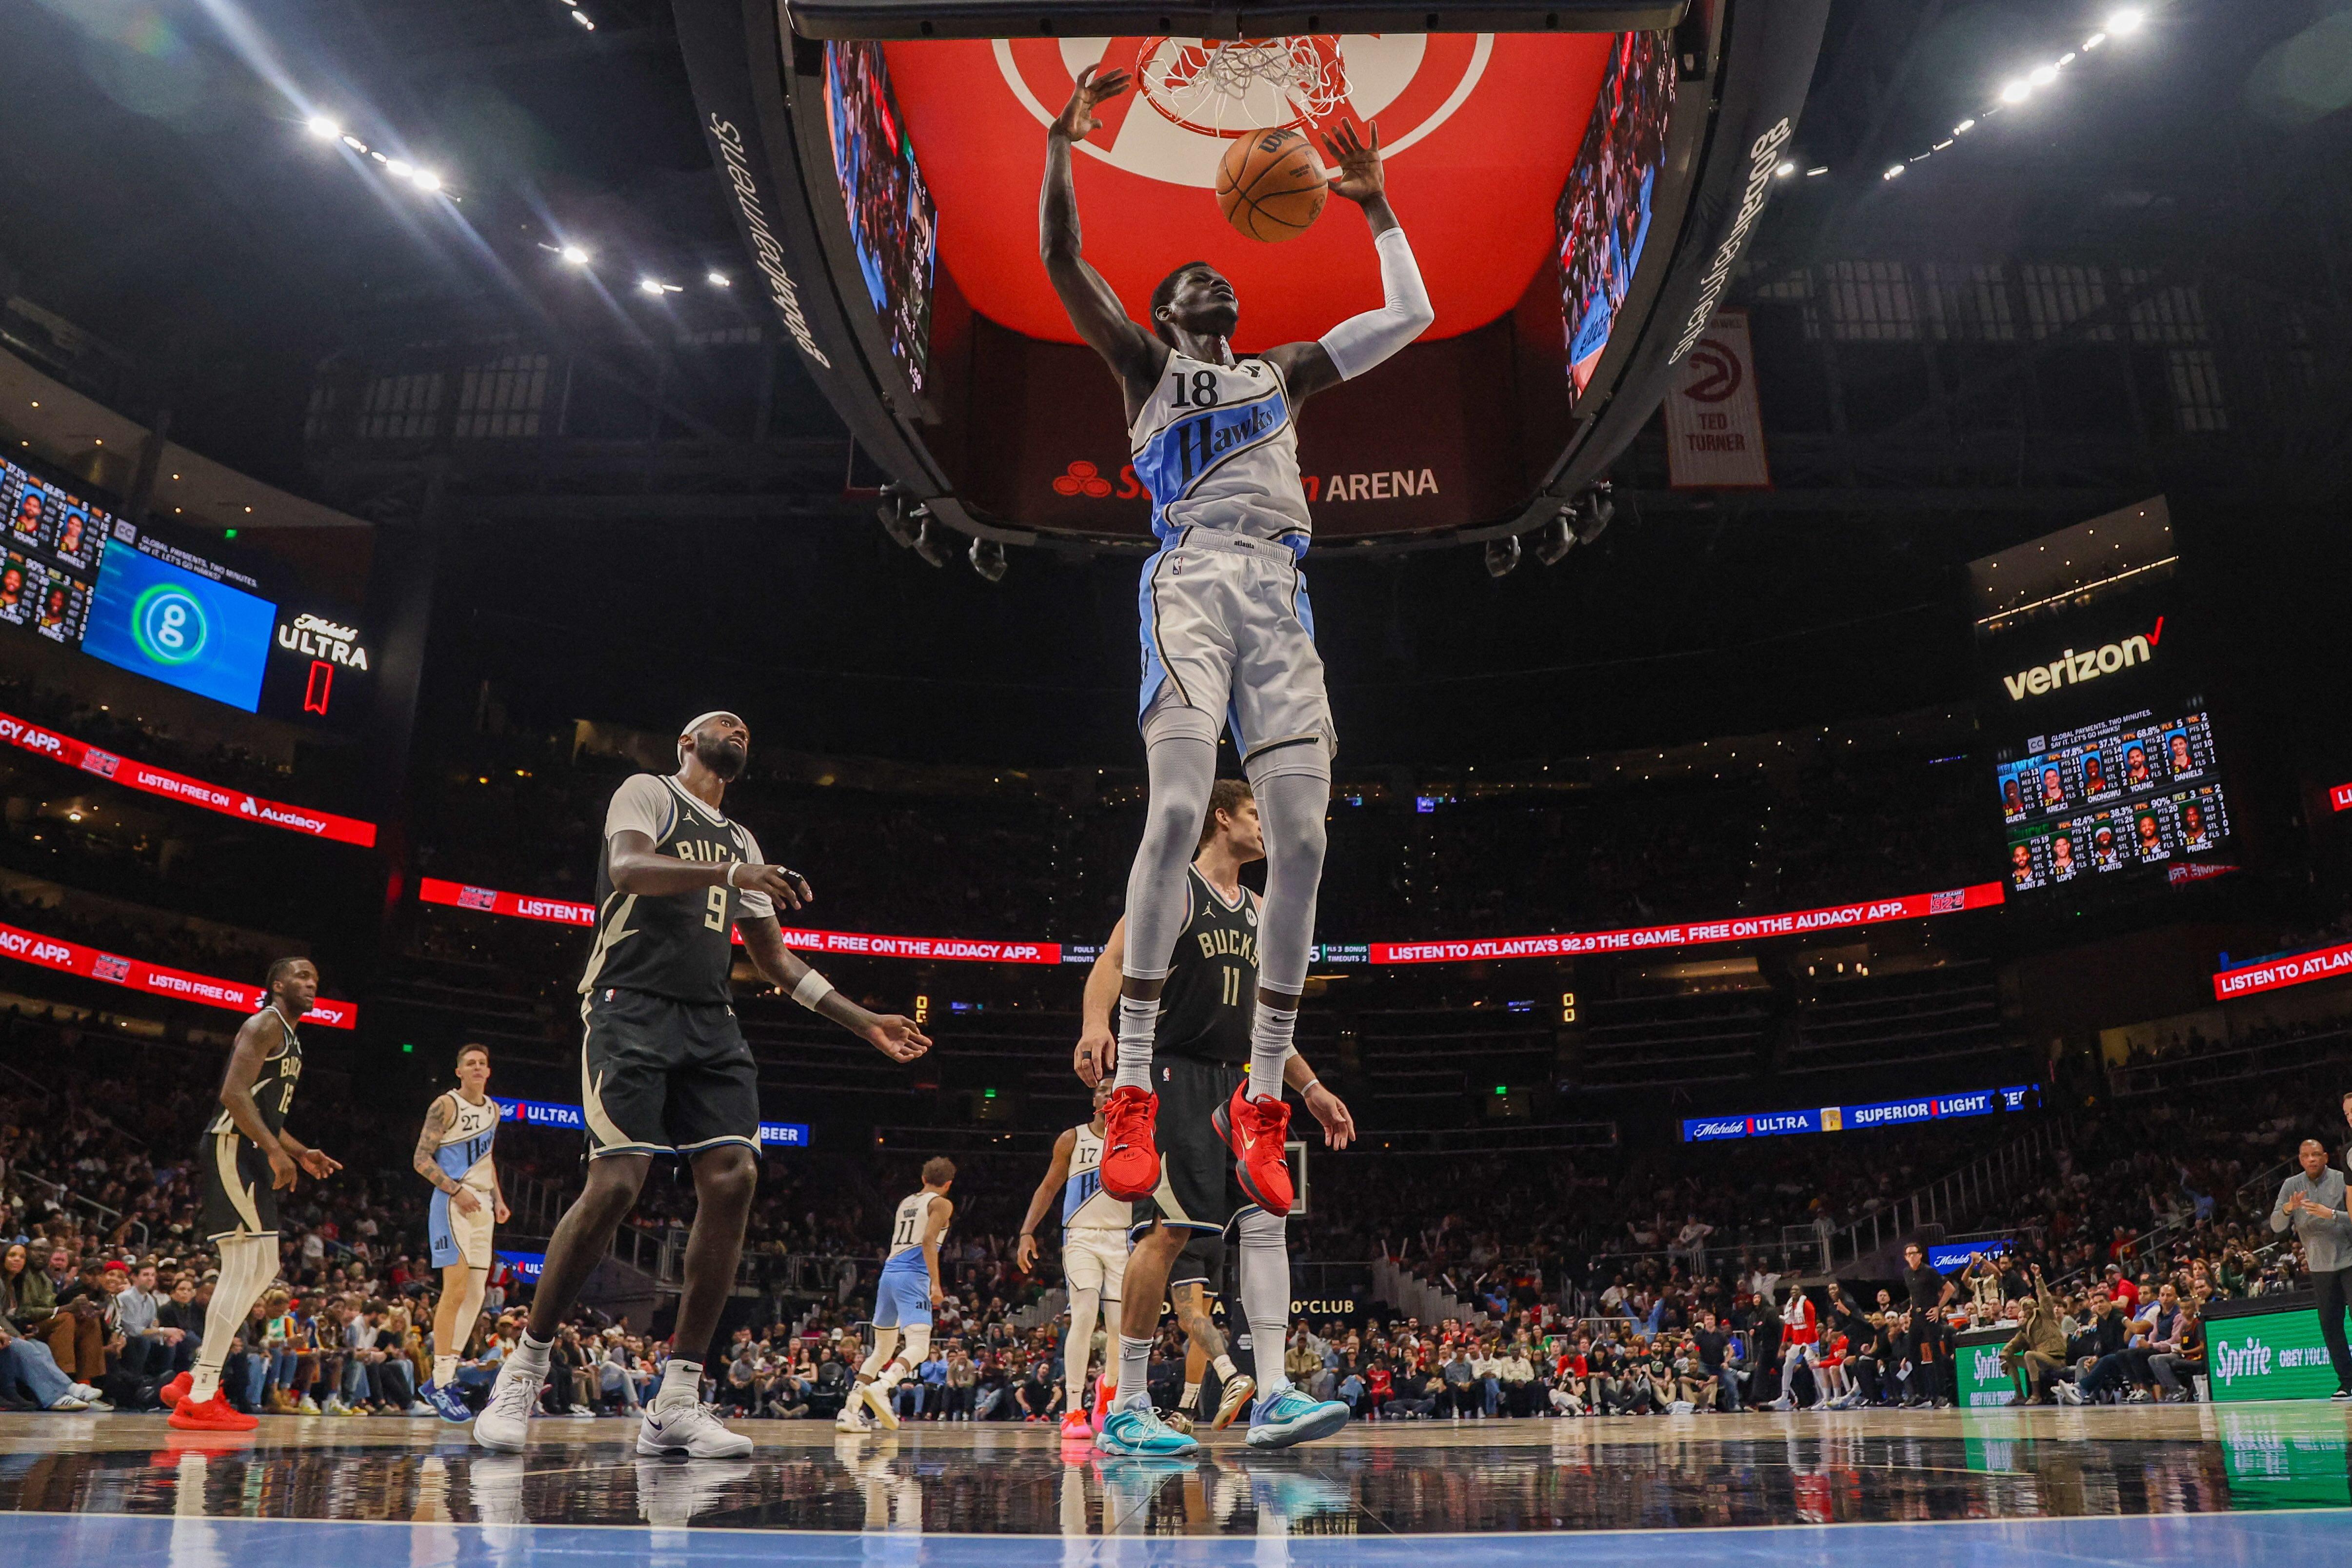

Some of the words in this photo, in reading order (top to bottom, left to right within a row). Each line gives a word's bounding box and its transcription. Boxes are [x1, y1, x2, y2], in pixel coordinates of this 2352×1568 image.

[709, 112, 831, 369] globalpayments
[1668, 117, 1791, 365] globalpayments
[1710, 318, 1742, 329] AWKS
[1171, 370, 1218, 408] 18
[1698, 413, 1728, 431] TED
[1176, 406, 1274, 493] Hawks
[1686, 433, 1746, 452] TURNER
[1326, 468, 1440, 502] ARENA
[118, 524, 132, 538] CC
[1234, 539, 1255, 550] atlanta
[279, 624, 368, 671] ULTRA
[2003, 634, 2151, 701] verizon
[2051, 732, 2074, 742] GLOBAL
[2075, 721, 2108, 735] PAYMENTS,
[2108, 717, 2122, 726] TWO
[2123, 709, 2153, 723] MINUTES.
[2201, 722, 2210, 731] 15
[22, 729, 62, 756] APP.
[2031, 740, 2043, 749] CC
[2050, 740, 2061, 750] SAY
[2071, 734, 2087, 744] LET'S
[2097, 725, 2120, 737] HAWKS!
[2061, 746, 2084, 759] 47.8%
[2098, 735, 2121, 749] 37.1%
[2136, 725, 2160, 739] 68.8%
[2156, 734, 2165, 743] 21
[2113, 746, 2122, 754] 14
[2031, 768, 2039, 776] 13
[2129, 776, 2137, 785] 11
[2174, 768, 2204, 782] DANIELS
[2087, 788, 2095, 796] 17
[2130, 780, 2154, 793] YOUNG
[137, 771, 180, 793] LISTEN
[180, 783, 211, 802] FREE
[211, 792, 230, 807] ON
[259, 807, 327, 834] Audacy
[2045, 798, 2053, 806] 27
[2087, 789, 2121, 803] OKONGWU
[2005, 808, 2013, 816] 18
[2046, 802, 2069, 814] KREJCI
[2110, 805, 2133, 819] 38.3%
[2151, 795, 2171, 809] 90%
[2169, 805, 2178, 814] 20
[2005, 812, 2027, 824] GUEYE
[2125, 815, 2134, 823] 26
[2082, 825, 2091, 834] 14
[2041, 835, 2049, 844] 19
[2185, 836, 2195, 845] 12
[2187, 840, 2213, 853] PRINCE
[2142, 850, 2170, 864] LILLARD
[2098, 861, 2123, 873] PORTIS
[2015, 881, 2036, 892] TRENT
[2036, 879, 2047, 887] JR.
[518, 899, 578, 921] LISTEN
[704, 885, 727, 933] 9
[1389, 945, 1444, 960] LISTEN
[1446, 944, 1469, 958] TO
[1471, 938, 1559, 956] ATLANTA'S
[1561, 937, 1596, 952] 92.9
[1596, 933, 1630, 949] THE
[1632, 928, 1685, 945] GAME,
[1689, 924, 1731, 941] FREE
[1732, 921, 1758, 936] ON
[1758, 917, 1794, 933] THE
[1796, 907, 1864, 929] AUDACY
[1867, 902, 1907, 920] APP.
[31, 941, 72, 966] APP.
[781, 932, 824, 950] AME,
[827, 935, 869, 951] FREE
[871, 939, 896, 953] ON
[897, 940, 930, 955] THE
[933, 943, 1001, 958] AUDACY
[1002, 945, 1041, 960] APP.
[1197, 929, 1259, 969] BUCKS
[1223, 966, 1240, 1006] 11
[2221, 967, 2276, 993] LISTEN
[2275, 963, 2300, 980] TO
[148, 973, 193, 993] LISTEN
[192, 982, 223, 999] FREE
[224, 989, 244, 1003] ON
[302, 1007, 343, 1023] acy
[461, 1114, 480, 1131] 27
[527, 1106, 579, 1124] ULTRA
[760, 1127, 798, 1141] BEER
[1694, 1121, 1744, 1137] Michelob
[1756, 1115, 1809, 1131] ULTRA
[1855, 1103, 1929, 1123] SUPERIOR
[1940, 1096, 1986, 1114] LIGHT
[1079, 1148, 1098, 1164] 17
[894, 1220, 915, 1245] 11
[2216, 1336, 2272, 1386] Sprite
[2279, 1348, 2303, 1367] OBEY
